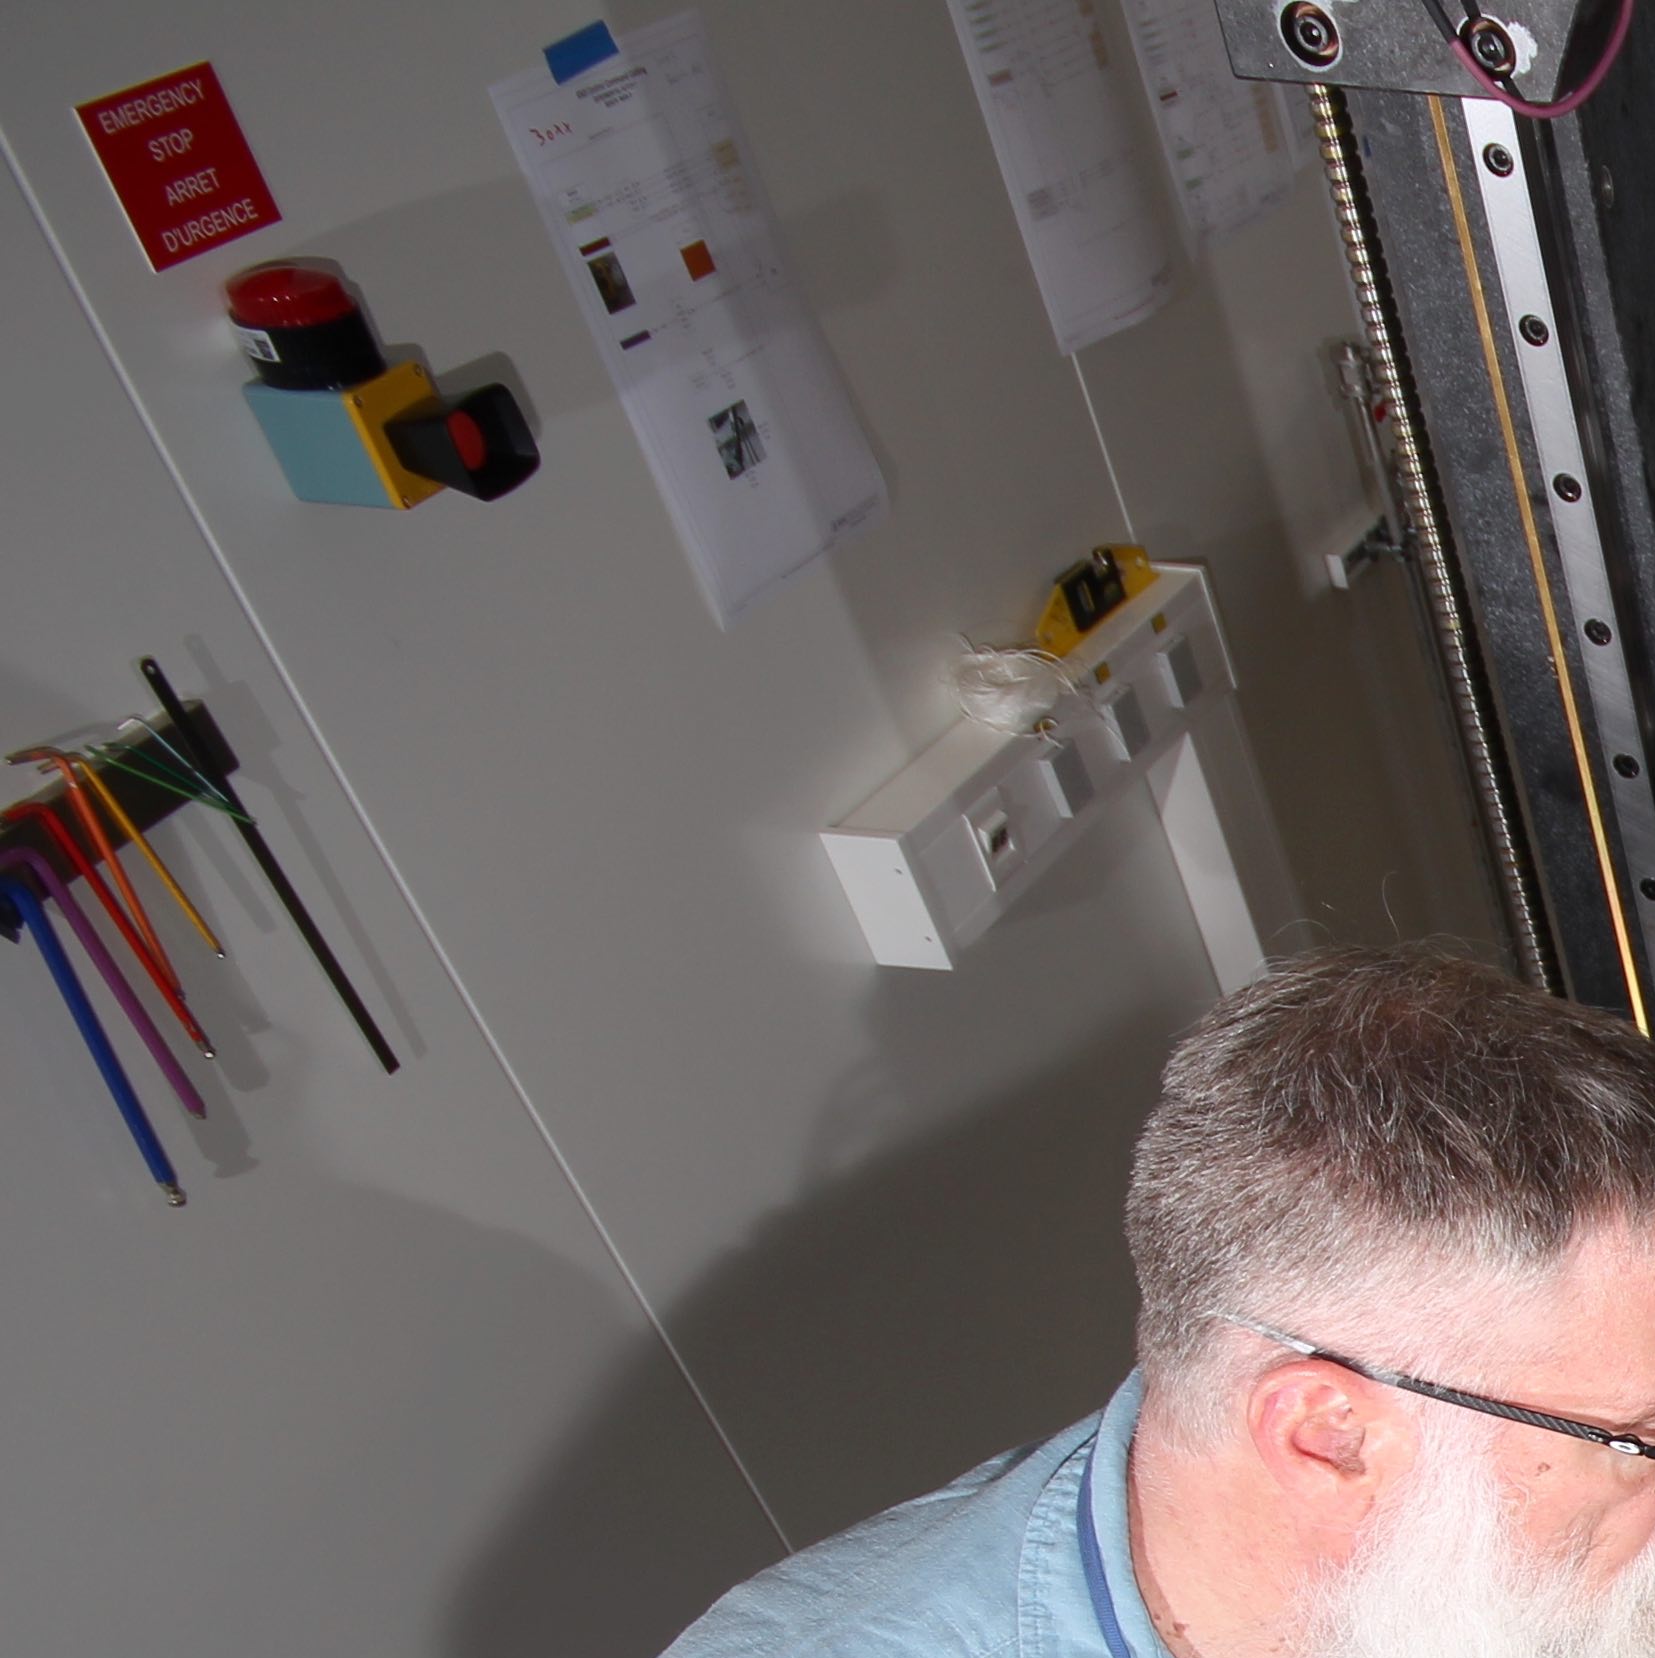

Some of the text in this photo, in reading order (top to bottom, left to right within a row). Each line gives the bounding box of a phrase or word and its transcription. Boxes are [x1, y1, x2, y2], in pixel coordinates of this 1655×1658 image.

[98, 79, 205, 134] EMERGENCY
[148, 128, 193, 162] STOP
[164, 168, 220, 206] ARRET
[161, 198, 258, 253] D'URGENCE
